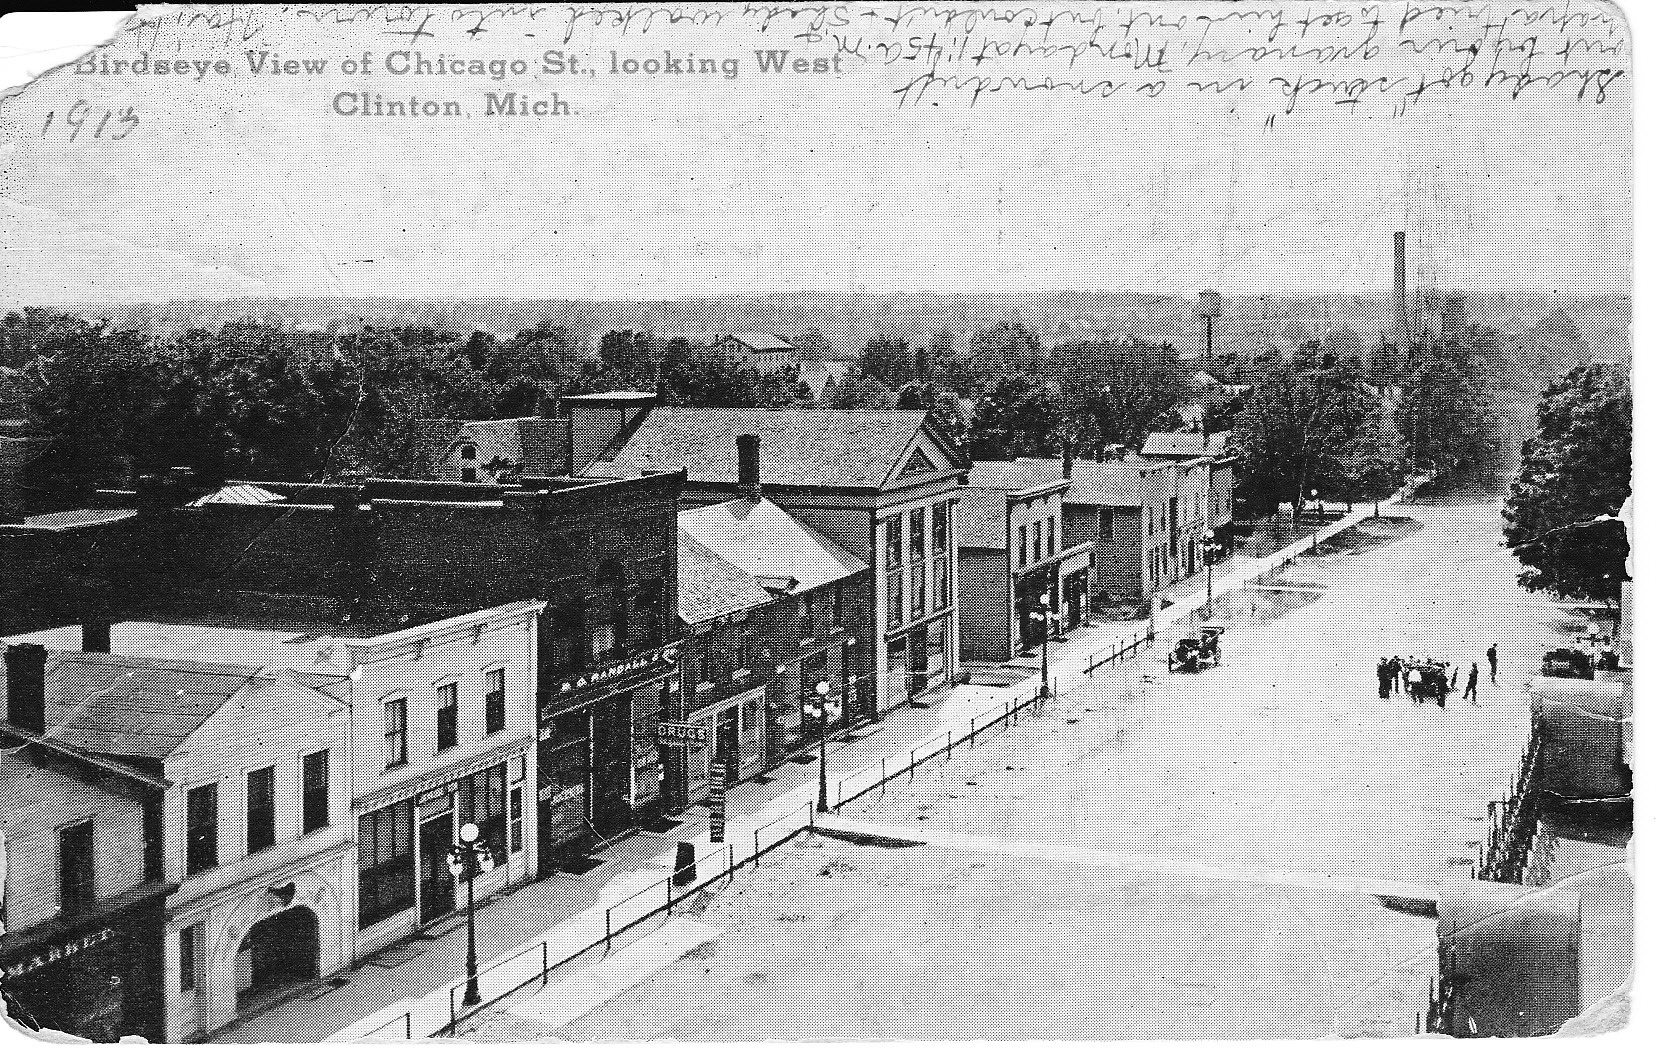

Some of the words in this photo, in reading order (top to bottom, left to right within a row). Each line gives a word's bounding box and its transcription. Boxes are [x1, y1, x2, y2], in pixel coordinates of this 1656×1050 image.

[562, 4, 732, 44] walked
[41, 99, 140, 143] 1913
[657, 725, 707, 741] DRUGS
[7, 928, 115, 981] MARKET
